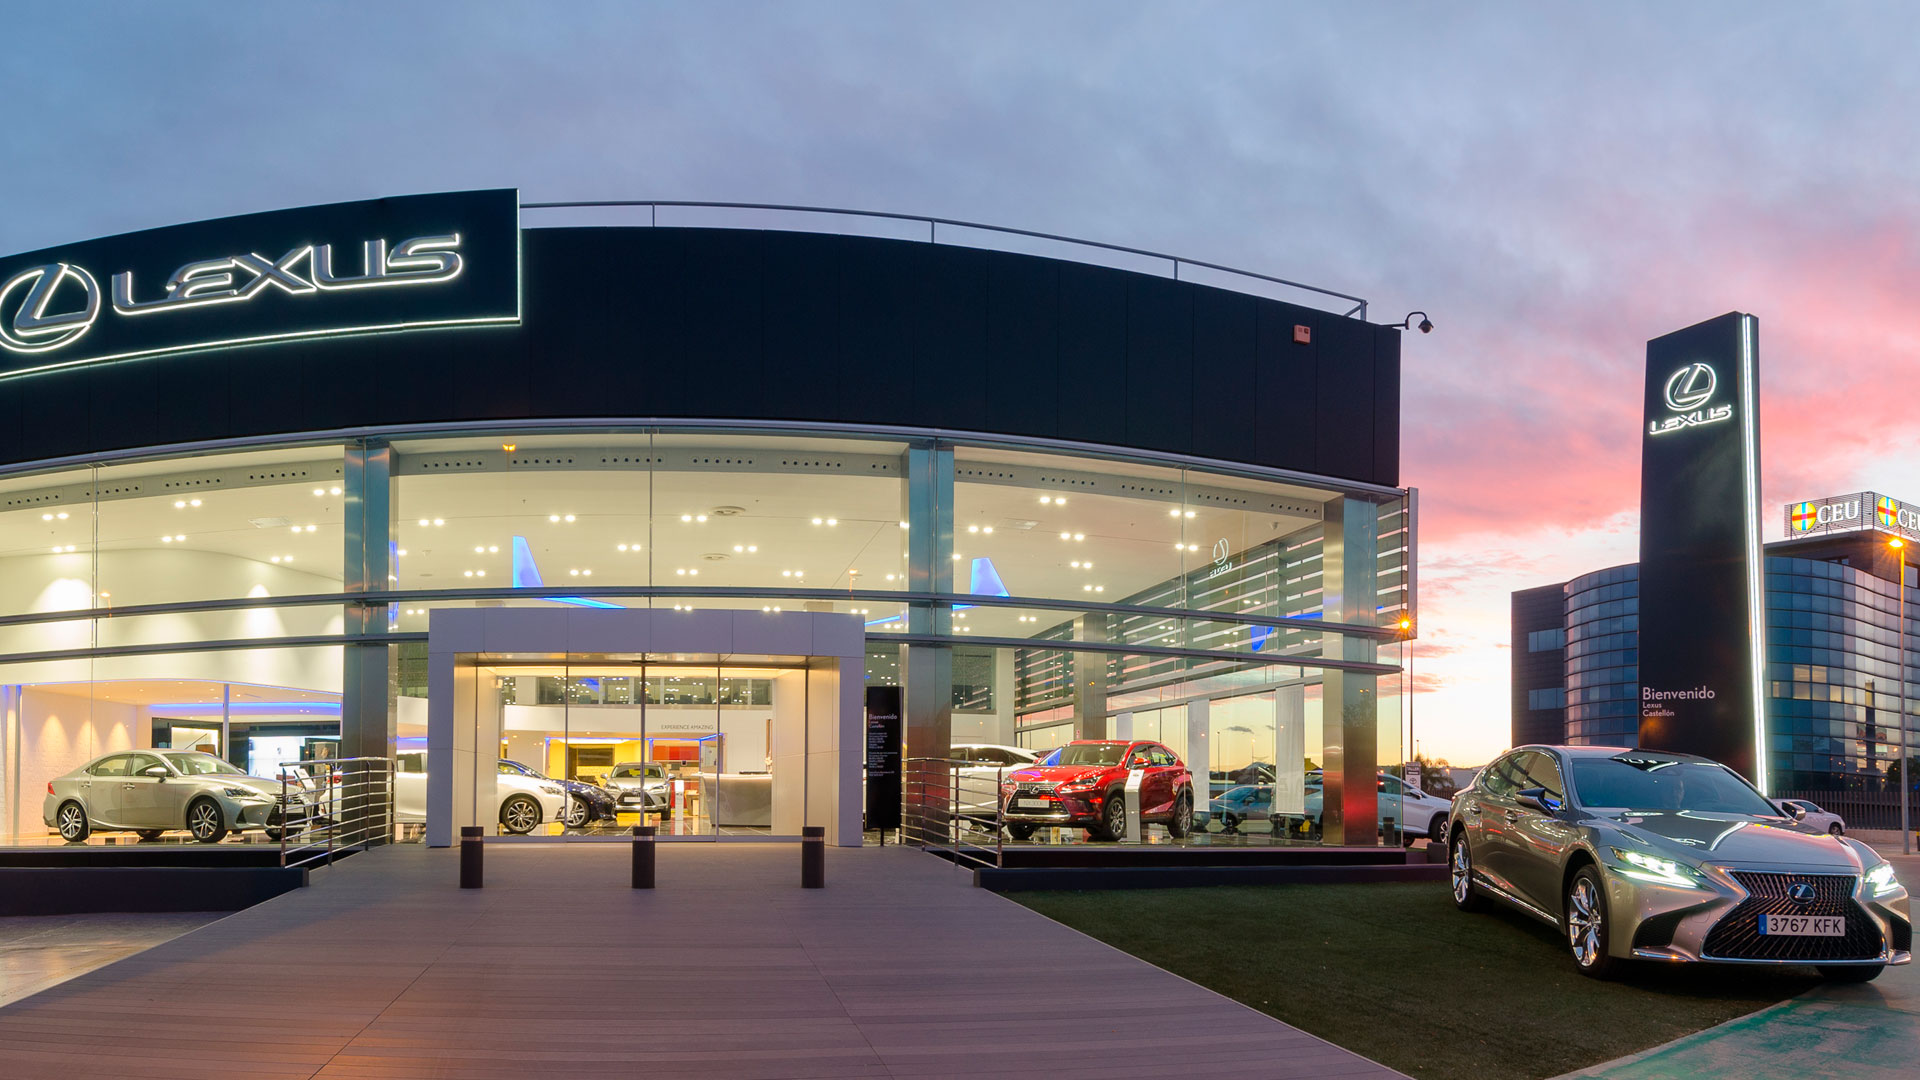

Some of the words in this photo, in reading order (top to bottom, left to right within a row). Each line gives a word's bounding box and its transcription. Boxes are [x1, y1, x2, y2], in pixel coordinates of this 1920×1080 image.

[112, 233, 463, 316] LEXUS
[1649, 404, 1732, 435] LEXUS
[1817, 500, 1860, 524] CEU
[1897, 508, 1920, 533] CE
[1642, 685, 1716, 701] Bienvenido
[1642, 701, 1662, 709] Lexus
[1642, 709, 1675, 717] Castellón
[1770, 917, 1809, 933] 3767
[1813, 918, 1841, 934] KFK
